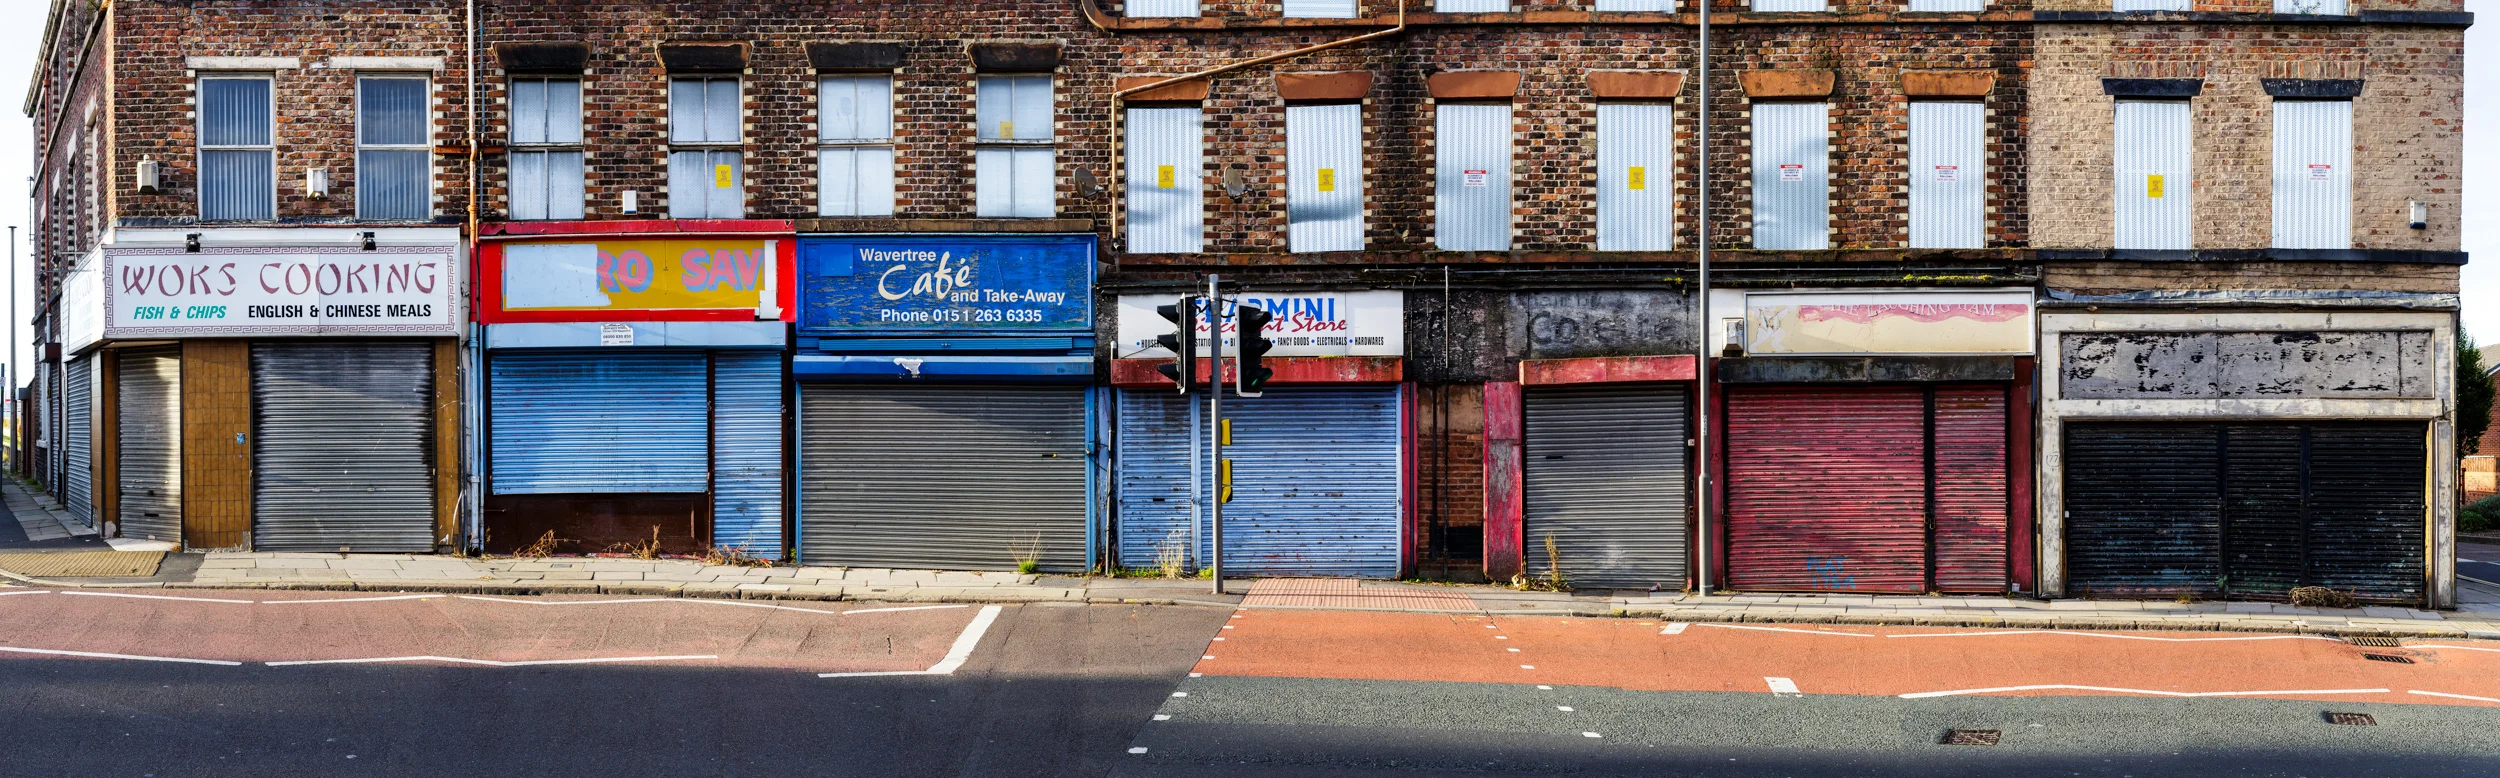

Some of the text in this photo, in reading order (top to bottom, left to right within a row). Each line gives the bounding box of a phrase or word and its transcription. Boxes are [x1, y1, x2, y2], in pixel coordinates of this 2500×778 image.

[859, 248, 937, 262] Wavertree
[122, 262, 436, 297] WOKS COOKING
[596, 248, 765, 293] RO SAV
[878, 251, 1065, 306] Café and Take-Away
[133, 305, 227, 320] FISH & CHIPS
[248, 304, 432, 318] ENGLISH & CHINESE MEALS
[881, 308, 929, 322] Phone
[975, 309, 1002, 322] 263
[1006, 309, 1042, 322] 6335
[1291, 311, 1347, 333] Store
